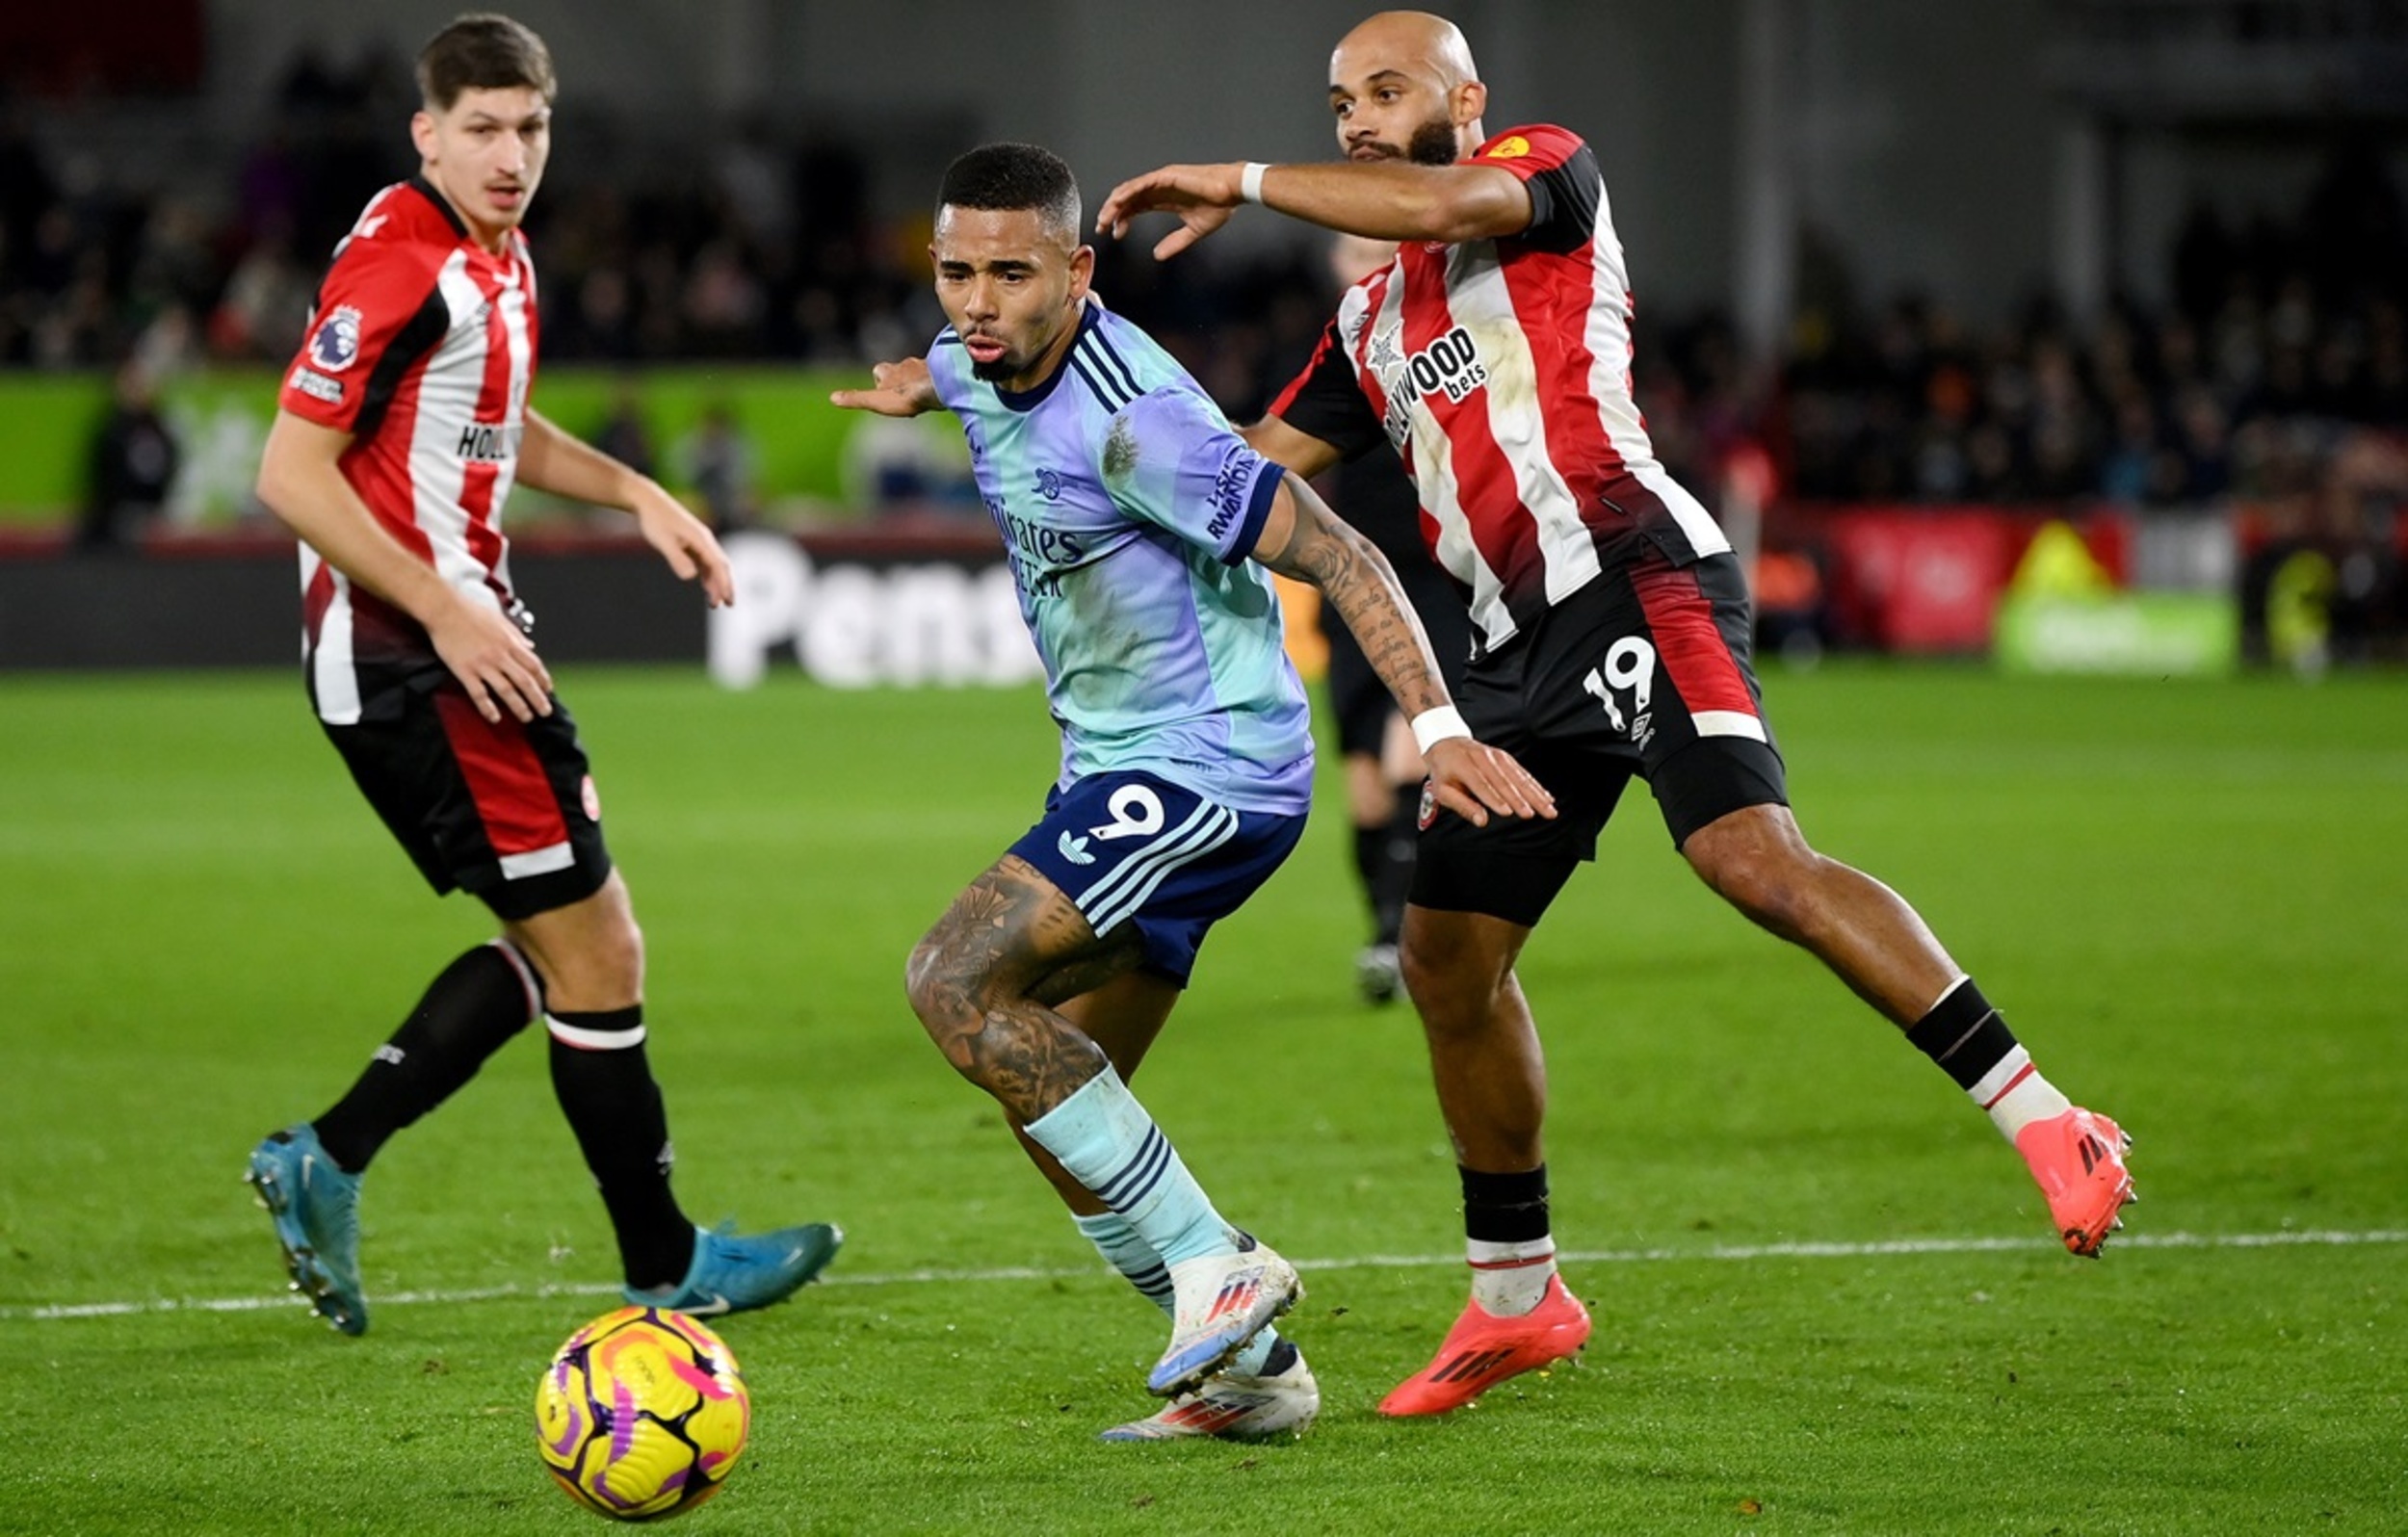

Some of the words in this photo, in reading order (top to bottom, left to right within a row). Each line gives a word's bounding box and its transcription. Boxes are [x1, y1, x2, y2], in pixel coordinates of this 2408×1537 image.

[1445, 363, 1486, 401] bets
[983, 496, 1085, 564] mirates
[1206, 459, 1255, 540] RWANDA
[1583, 636, 1656, 733] 19
[1088, 784, 1165, 841] 9
